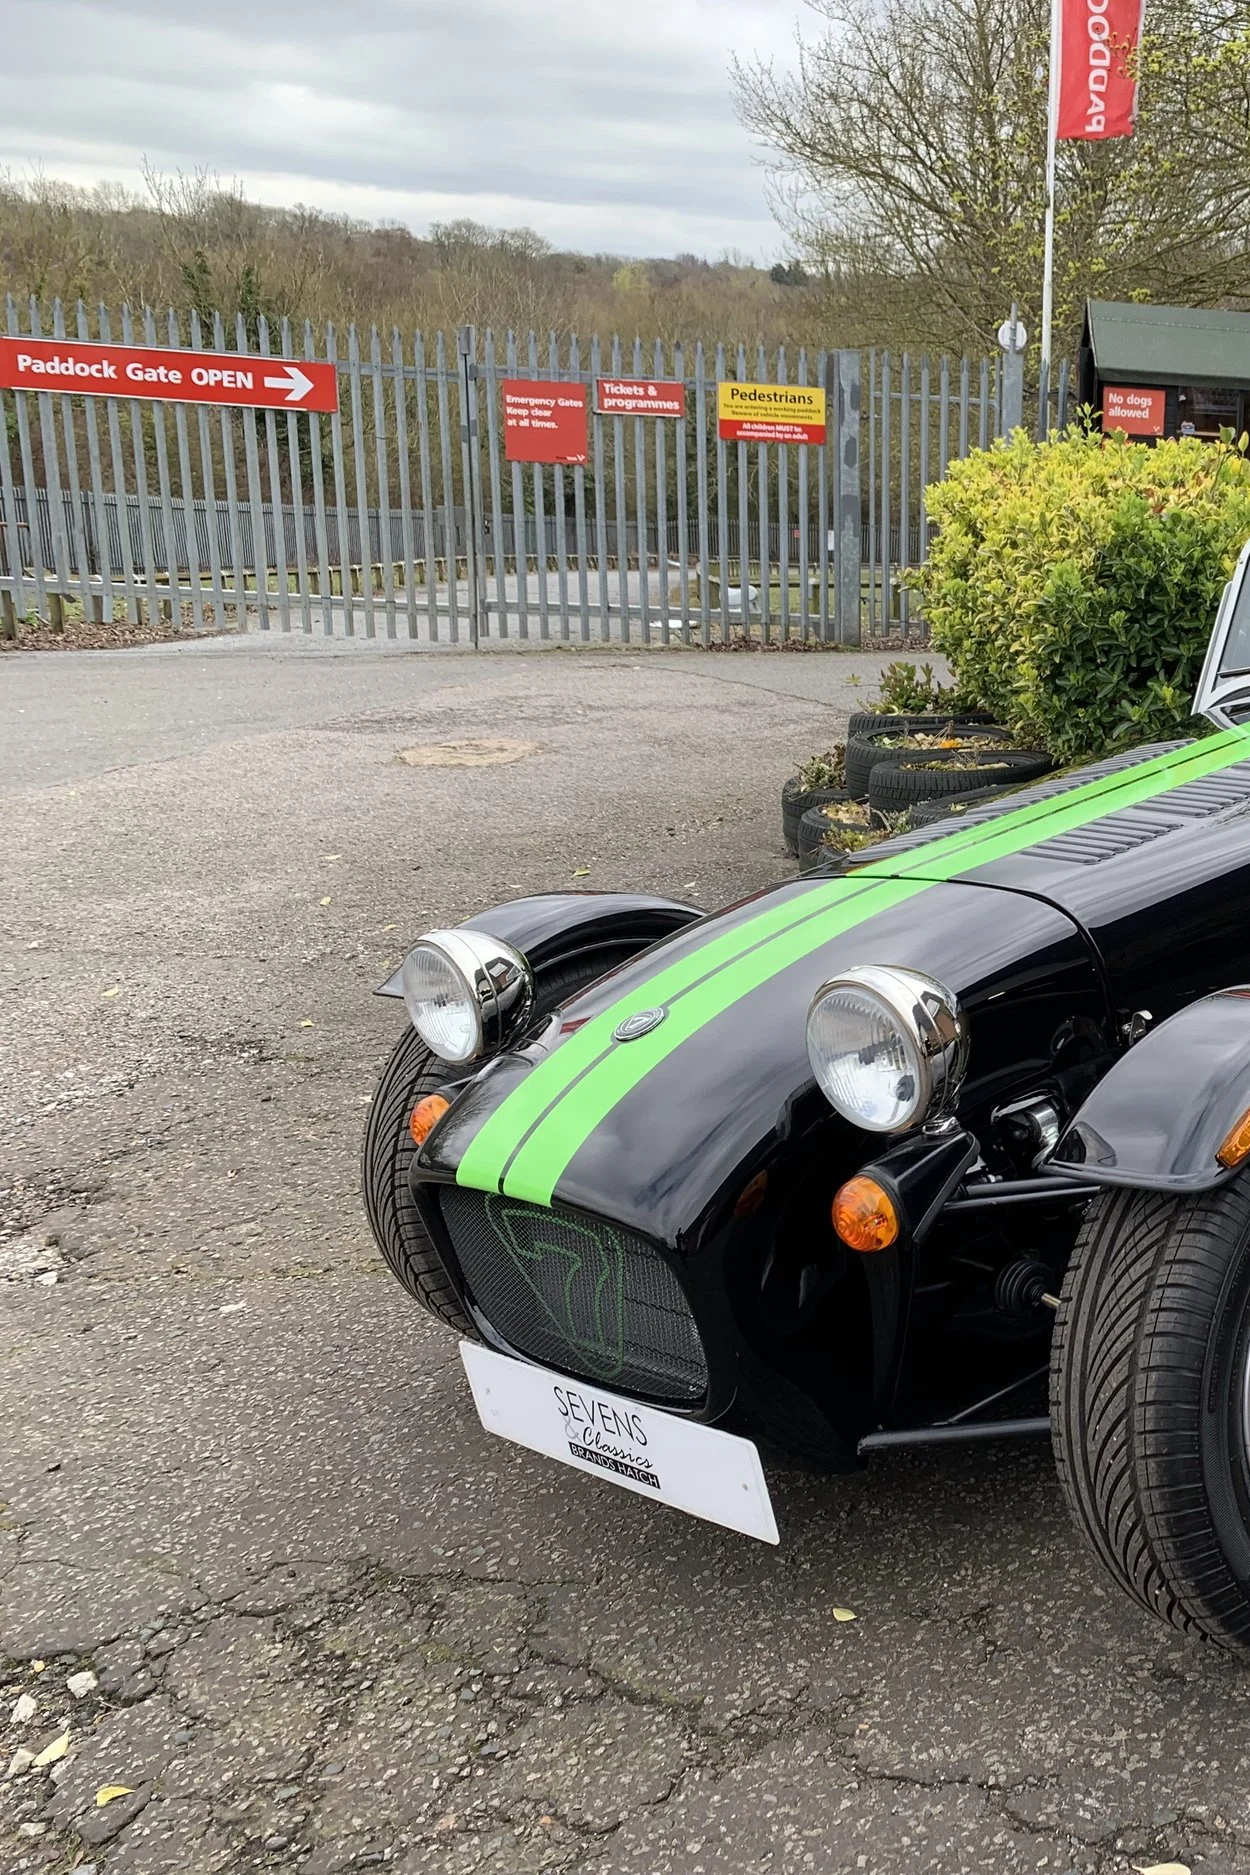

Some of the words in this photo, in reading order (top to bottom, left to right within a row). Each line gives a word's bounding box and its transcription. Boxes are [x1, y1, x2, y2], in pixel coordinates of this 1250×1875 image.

[16, 354, 118, 379] Paddock
[125, 362, 183, 385] Gate
[191, 368, 254, 389] OPEN
[603, 383, 645, 396] Tickets
[647, 385, 658, 397] &
[731, 388, 813, 404] Pedestrians
[506, 394, 556, 408] Emergency
[557, 398, 584, 408] Gates
[603, 398, 680, 410] programmes
[1109, 393, 1123, 404] No
[1127, 394, 1152, 408] dogs
[506, 406, 529, 417] Keep
[530, 408, 553, 417] clear
[1108, 406, 1149, 418] allowed
[507, 419, 517, 427] at
[519, 418, 530, 427] all
[531, 419, 559, 429] times.
[742, 422, 751, 430] All
[751, 422, 775, 431] children
[775, 424, 794, 432] MUST
[736, 430, 775, 438] accompanied
[553, 1386, 648, 1446] SEVENS
[563, 1415, 582, 1443] &
[583, 1426, 654, 1469] Classics
[570, 1444, 616, 1471] BRANDS
[617, 1462, 659, 1488] HATCH
